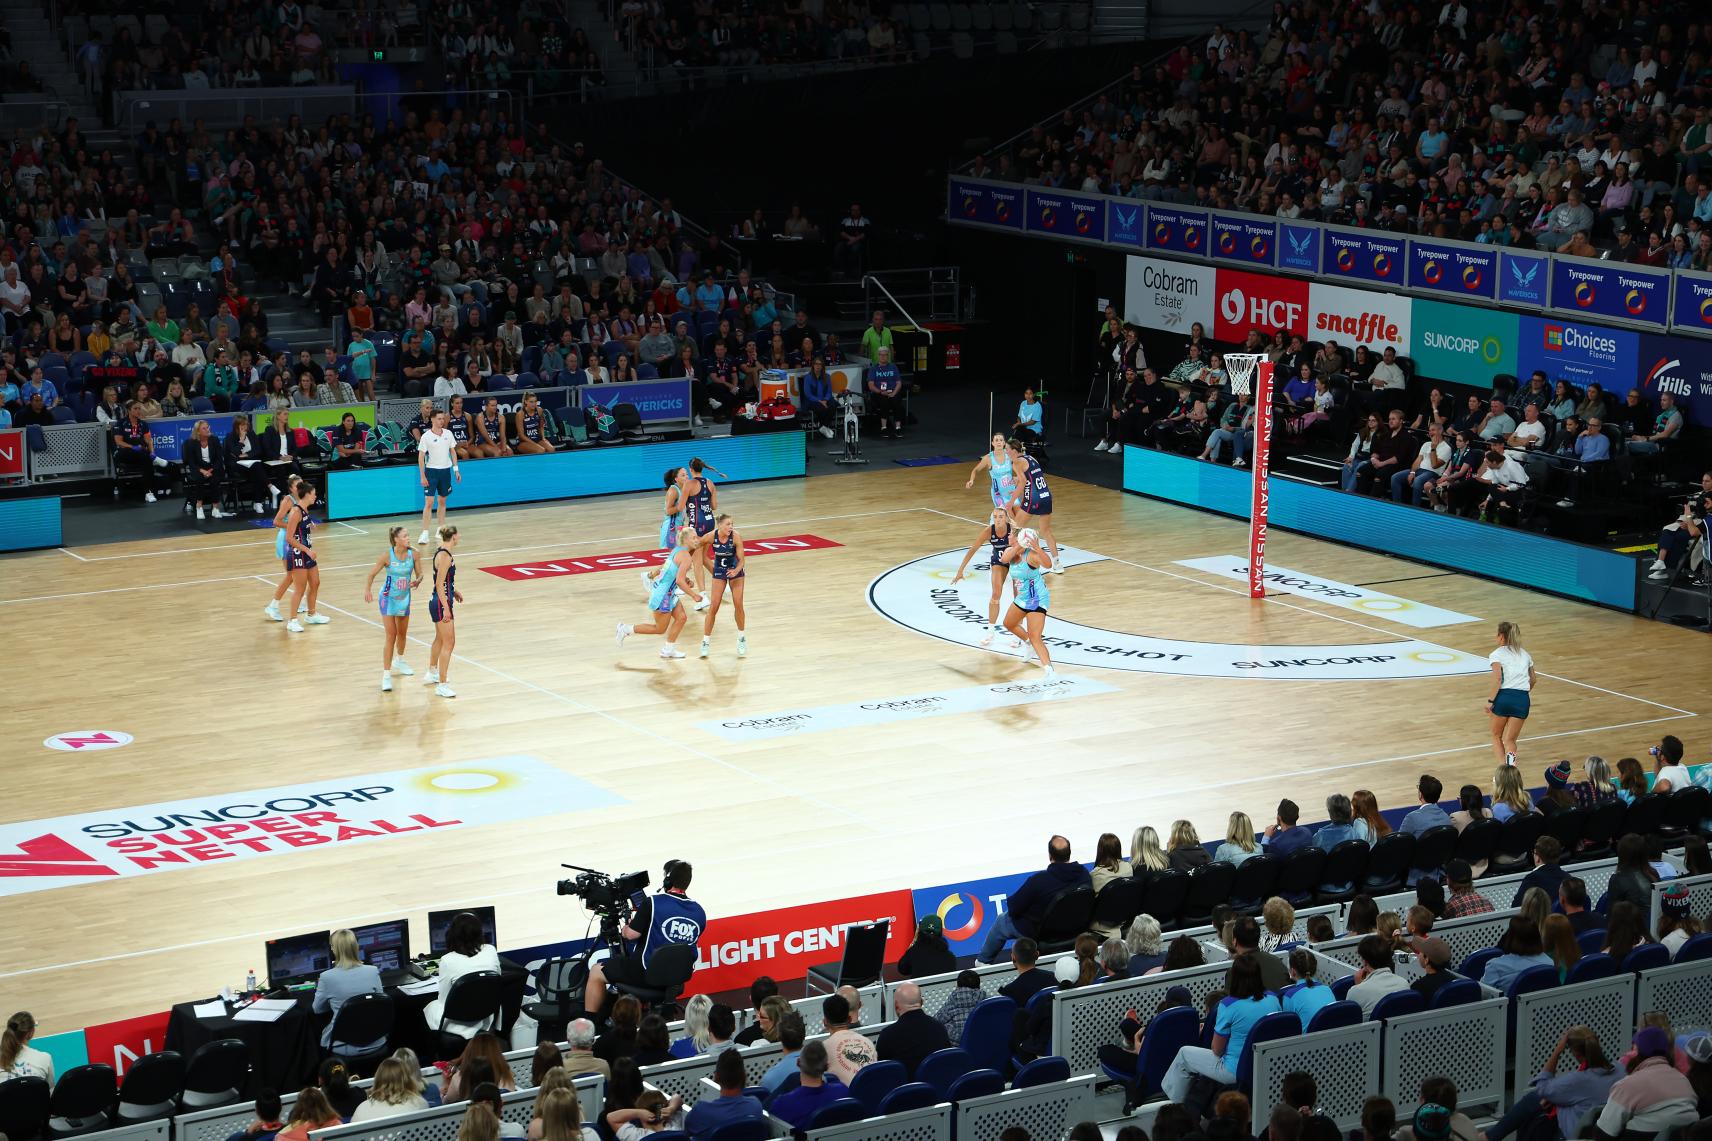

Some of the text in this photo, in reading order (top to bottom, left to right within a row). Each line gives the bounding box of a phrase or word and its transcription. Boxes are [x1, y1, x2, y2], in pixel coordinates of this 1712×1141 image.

[991, 191, 1015, 201] Tyrepower
[1037, 197, 1062, 208] Tyrepower
[1071, 202, 1096, 212] Tyrepower
[1150, 212, 1177, 223] Tyrepower
[1179, 216, 1207, 227] Tyrepower
[1214, 220, 1242, 232] Tyrepower
[1245, 224, 1274, 236] Tyrepower
[1331, 236, 1362, 249] Tyrepower
[1367, 241, 1399, 253] Tyrepower
[1417, 248, 1450, 260] Tyrepower
[1456, 253, 1489, 266] Tyrepower
[1143, 266, 1198, 296] Cobram
[1568, 269, 1604, 282] Tyrepower
[1618, 276, 1655, 290] Tyrepower
[1508, 289, 1539, 299] MAVERICKS
[1693, 284, 1712, 297] Tyrep
[1154, 293, 1182, 309] Estate
[1250, 296, 1302, 330] HCF
[1423, 331, 1480, 354] SUNCORP
[1564, 327, 1616, 353] Choices
[1588, 350, 1616, 363] Flooring
[1657, 375, 1692, 396] Hills
[1254, 372, 1275, 591] NISSAN NISSAN NISSAN
[294, 558, 303, 567] 10
[1083, 645, 1193, 662] SHOT
[1231, 655, 1397, 669] SUNCORP
[860, 696, 947, 710] Cobram
[722, 714, 813, 729] Cobram
[82, 785, 395, 839] SUNCORP
[106, 811, 350, 854] SUPER
[128, 813, 464, 870] NETBALL
[671, 920, 697, 937] FOX
[693, 934, 780, 972] LIGHT
